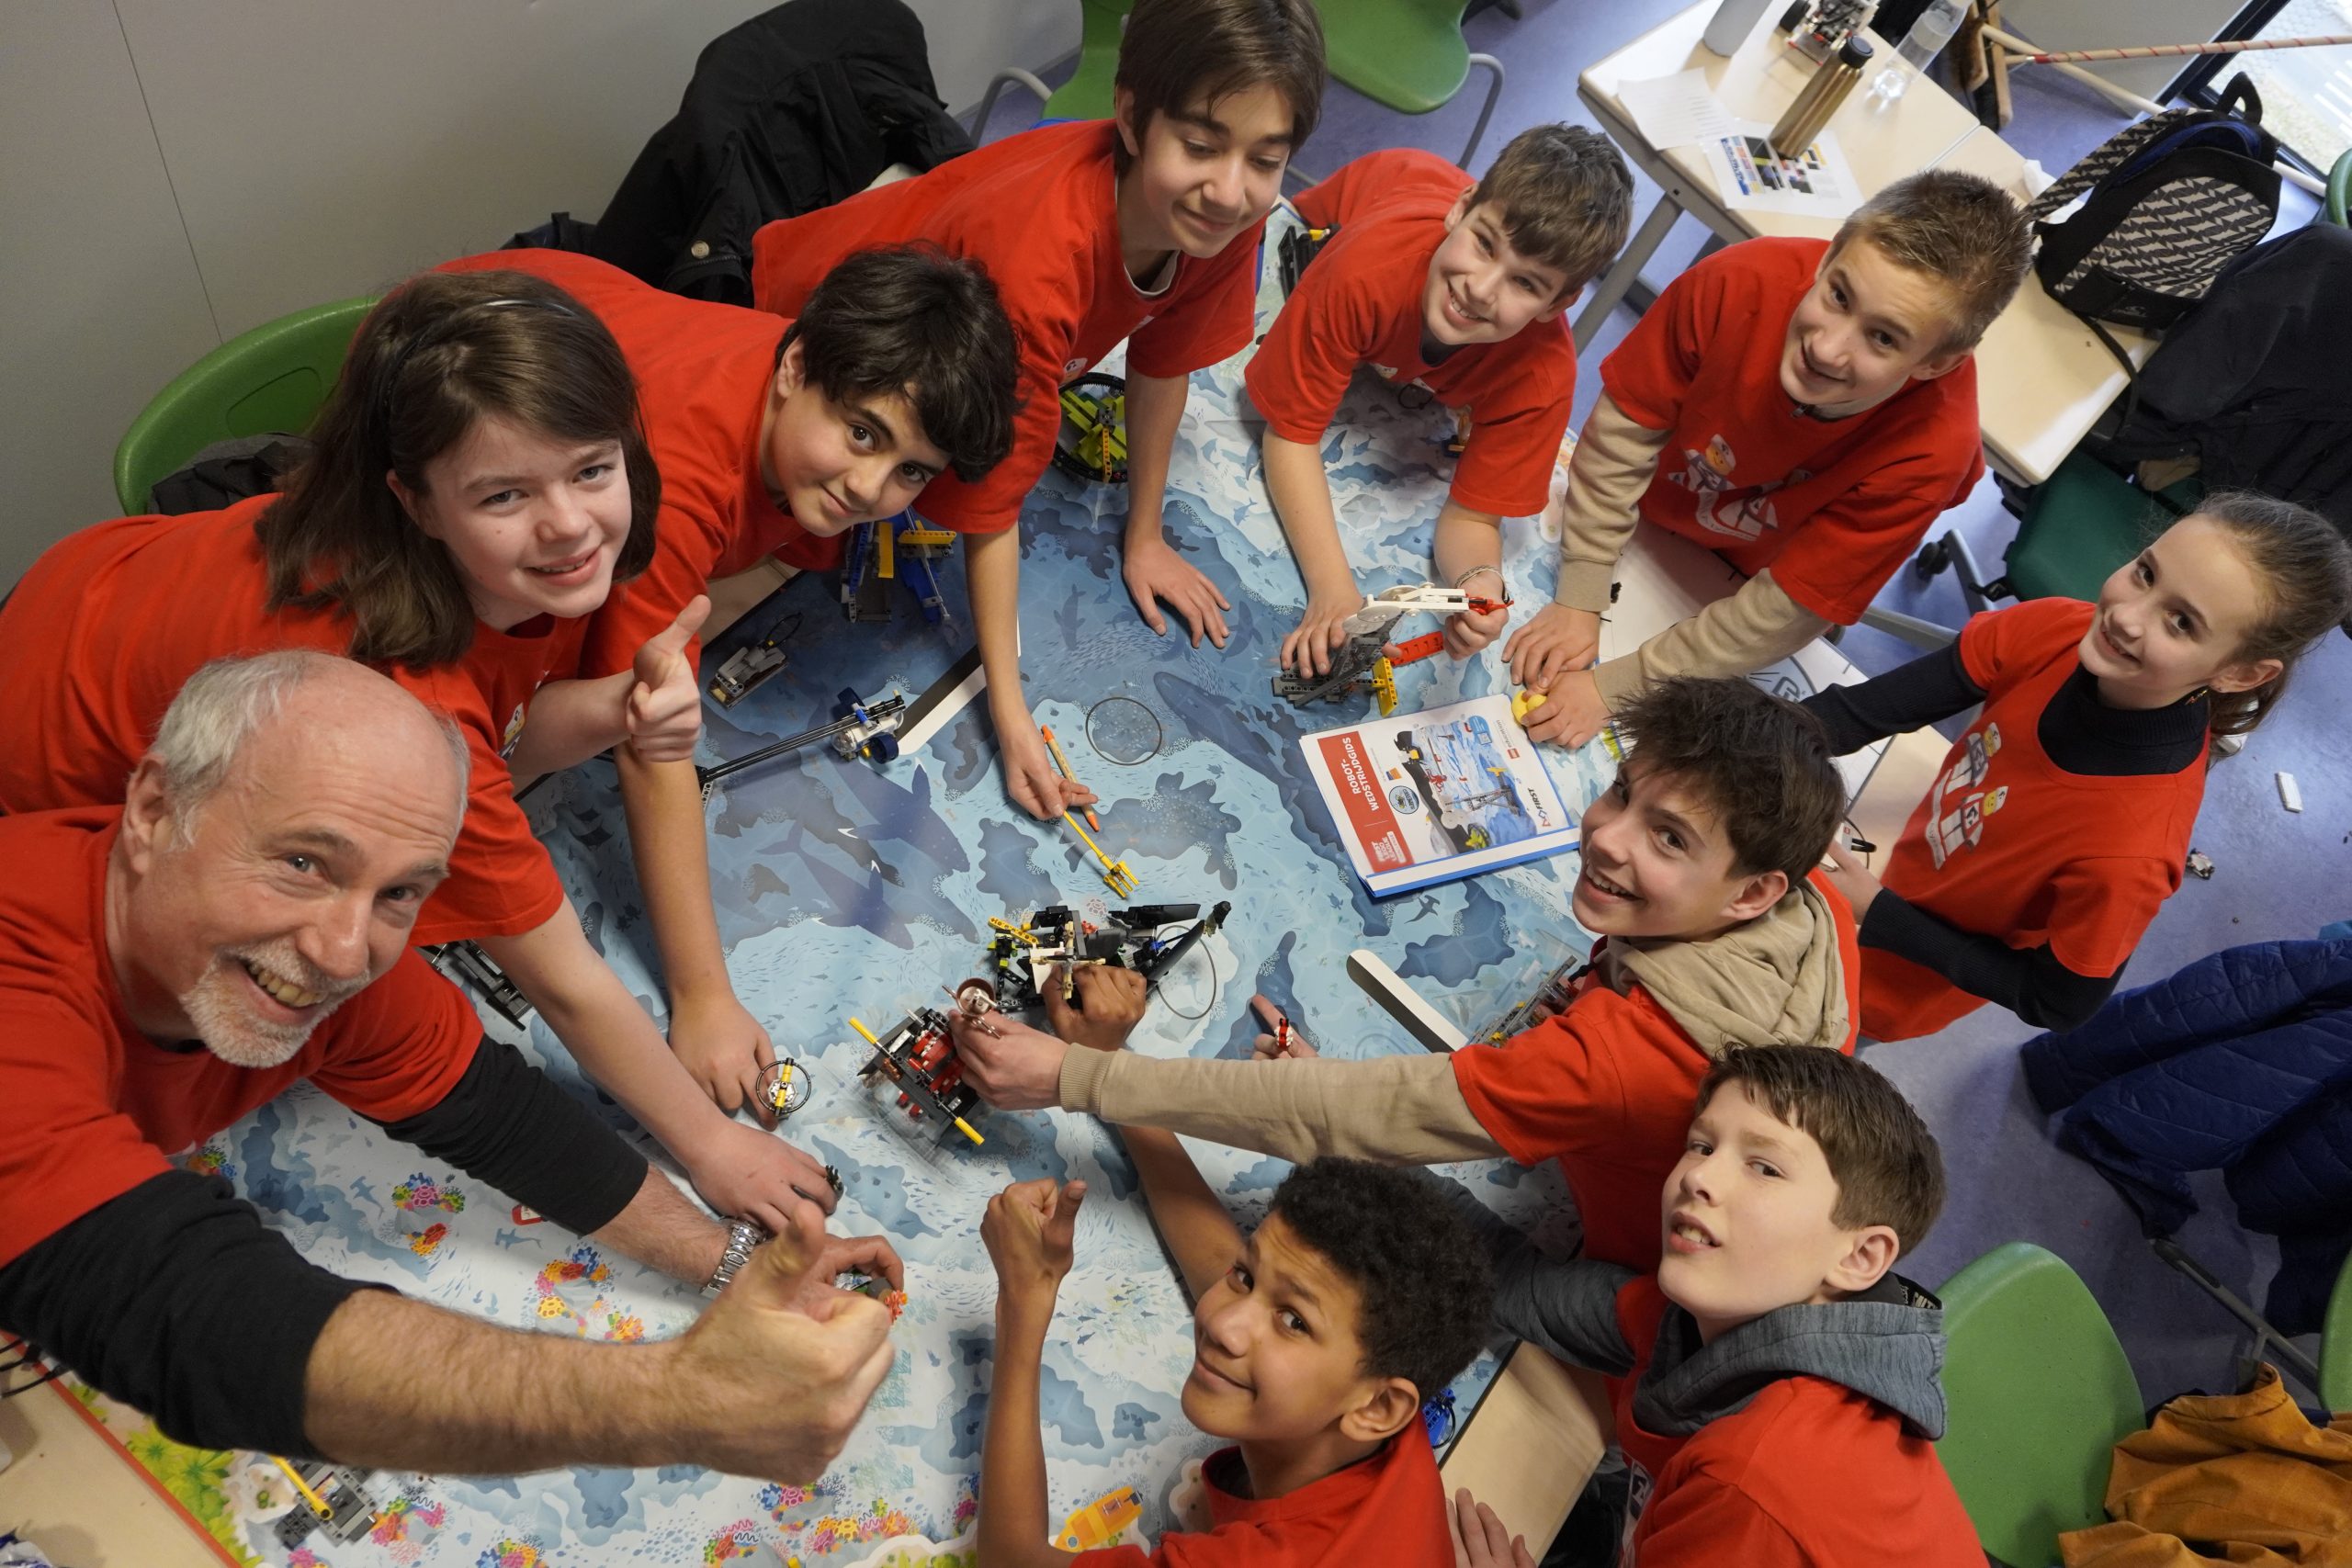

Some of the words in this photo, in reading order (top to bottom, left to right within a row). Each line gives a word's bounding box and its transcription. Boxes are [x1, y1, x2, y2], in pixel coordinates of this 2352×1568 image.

[1340, 758, 1362, 795] ROBOT-
[1342, 737, 1379, 811] WEDSTRIJDGIDS
[1527, 787, 1543, 810] FIRST
